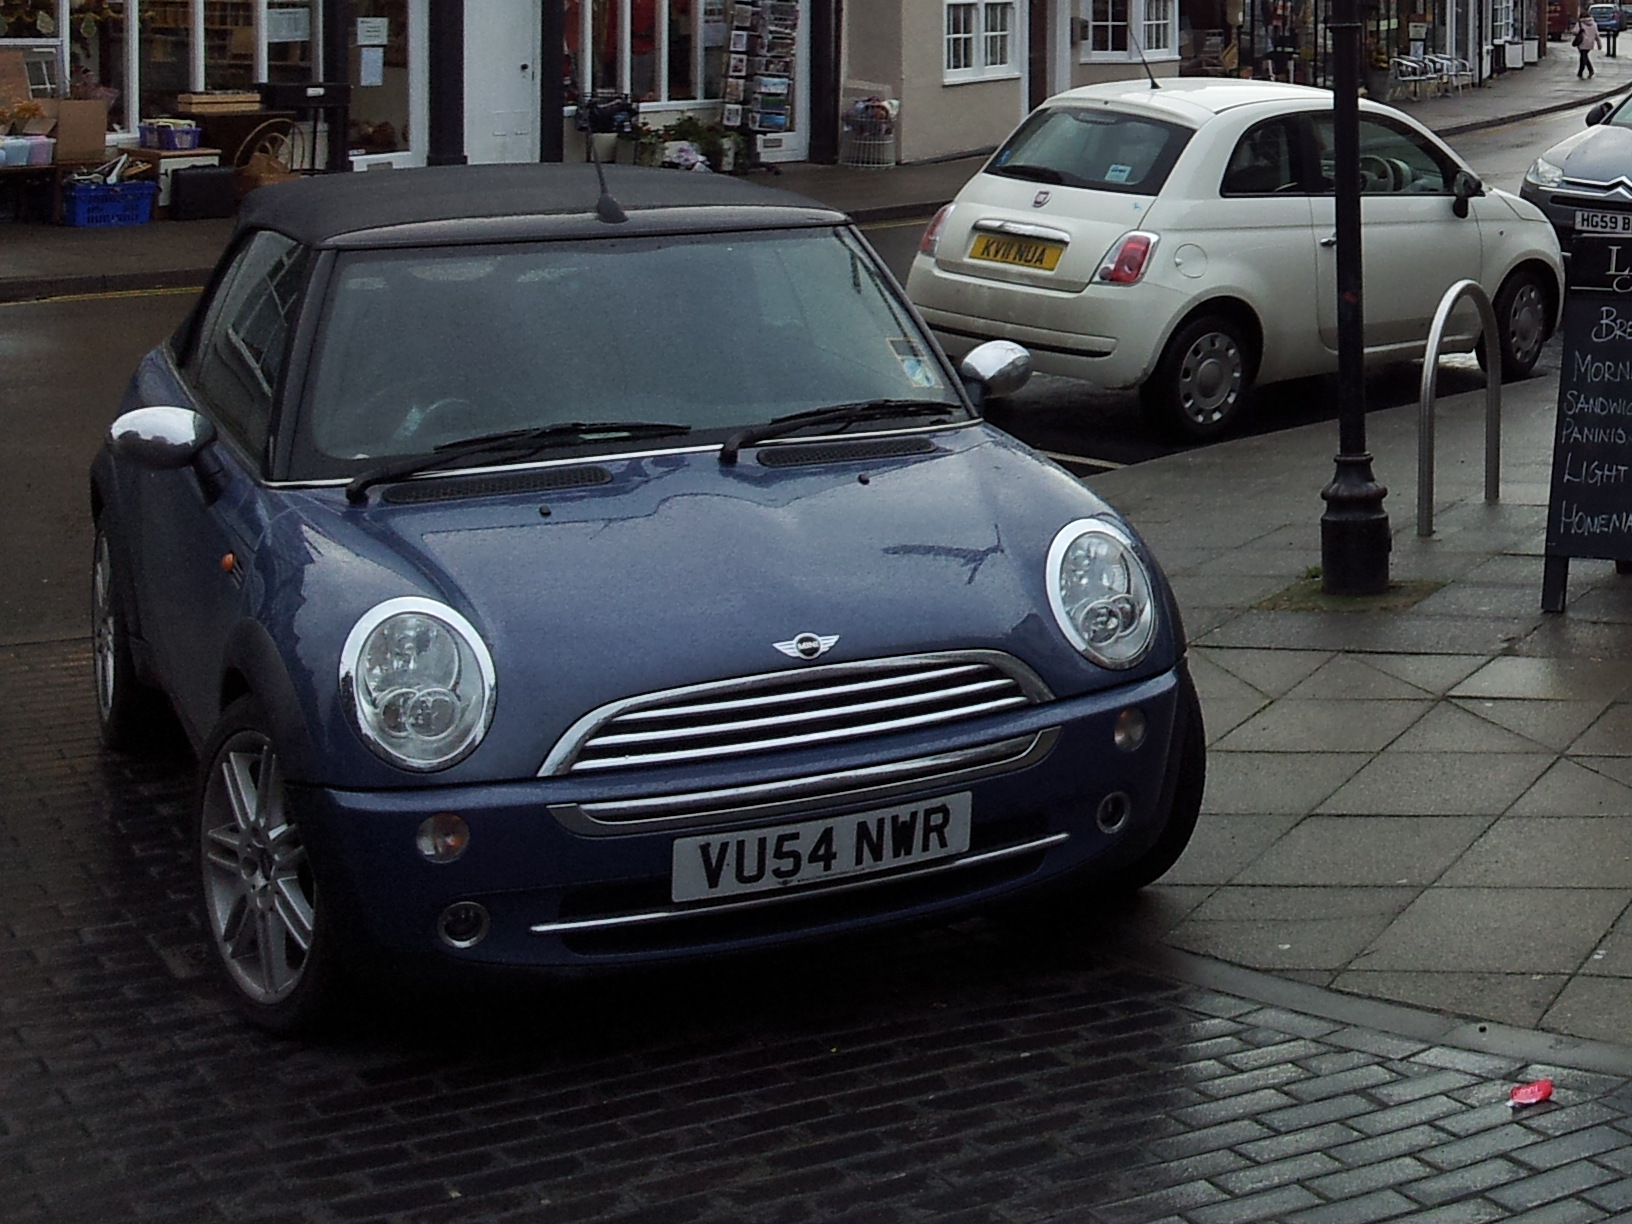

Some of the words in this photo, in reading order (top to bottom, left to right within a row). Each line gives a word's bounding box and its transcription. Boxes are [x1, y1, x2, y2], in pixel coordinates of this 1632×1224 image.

[1581, 214, 1618, 229] HG59
[1563, 452, 1629, 486] LIGHT
[797, 640, 819, 650] MINI
[698, 826, 837, 889] VU54
[854, 804, 951, 866] NWR
